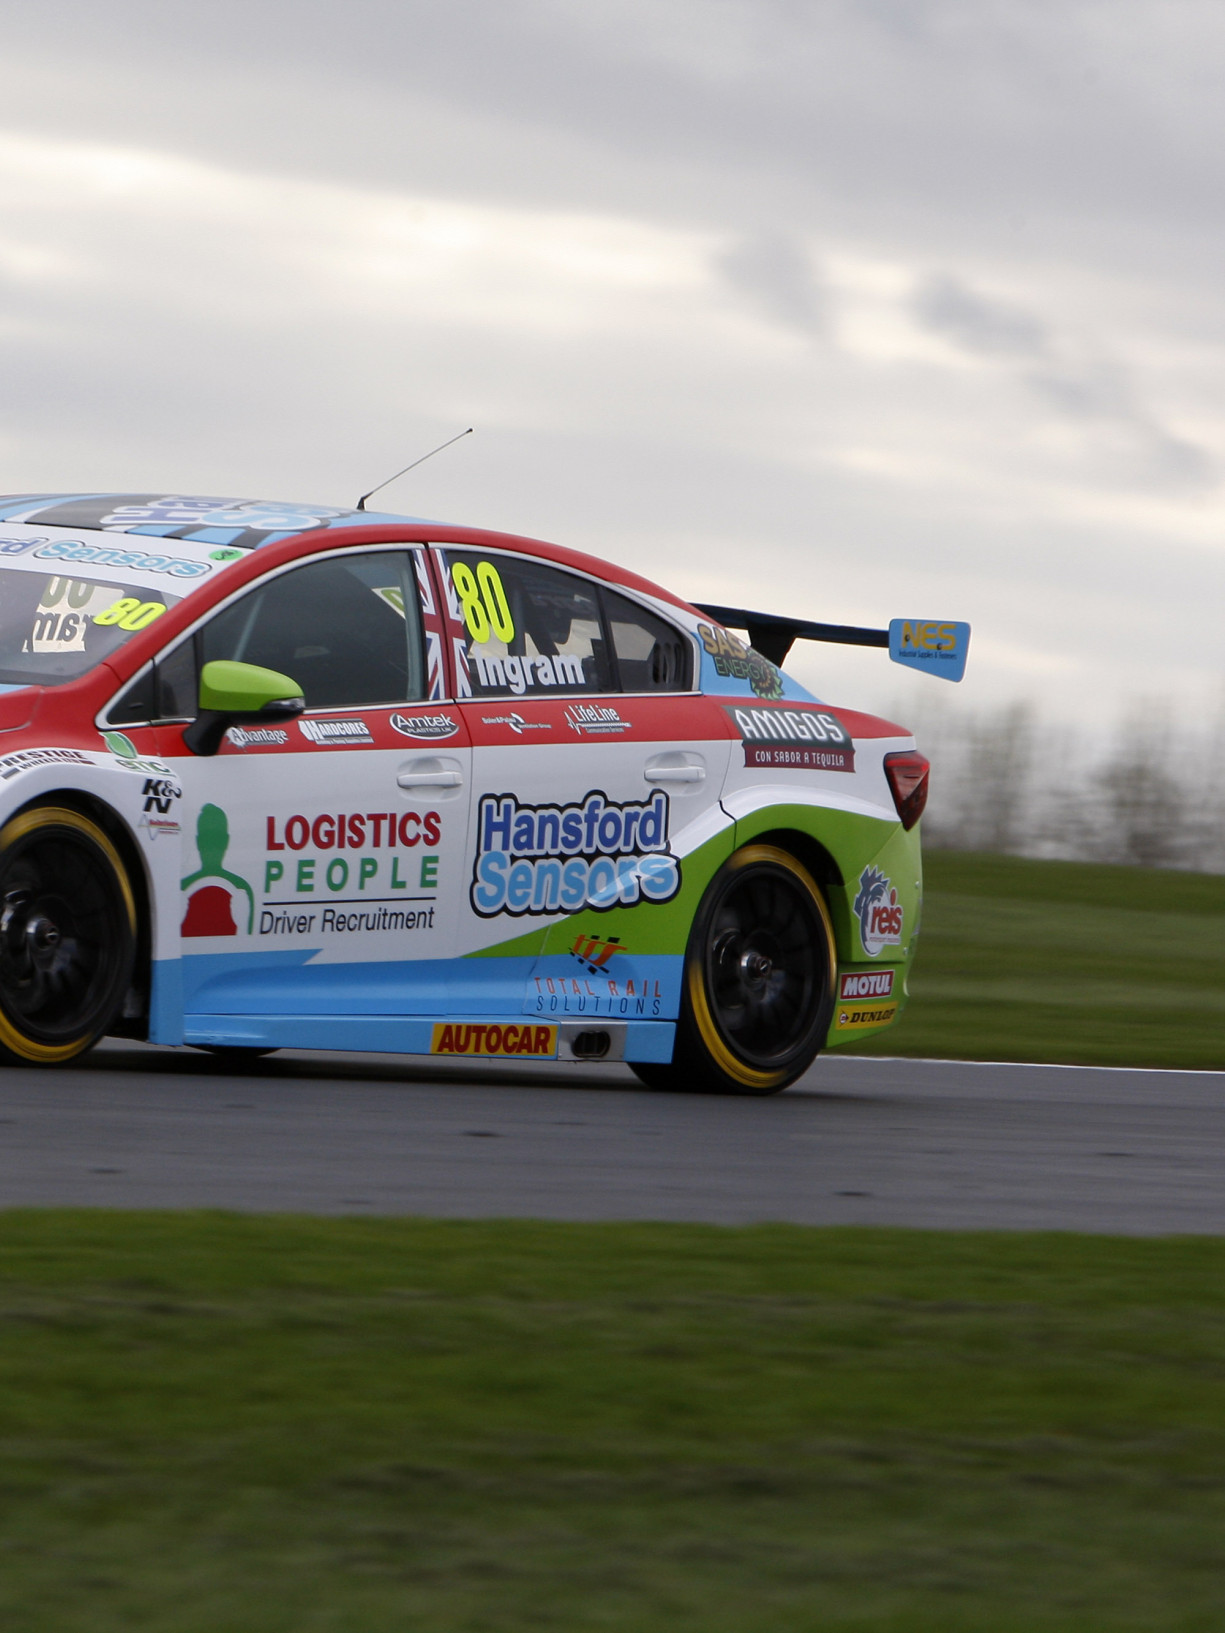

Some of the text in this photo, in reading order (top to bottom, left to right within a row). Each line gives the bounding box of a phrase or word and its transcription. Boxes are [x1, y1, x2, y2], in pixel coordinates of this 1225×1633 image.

[40, 541, 208, 576] Sensors
[92, 597, 167, 631] 80
[452, 561, 515, 643] 80
[698, 624, 748, 659] SAS
[901, 621, 956, 650] NES
[476, 648, 586, 695] Ingram
[714, 656, 765, 680] ENERGY
[397, 713, 456, 728] Amtek
[569, 704, 620, 722] LifeLine
[734, 709, 845, 743] AMIGOS
[304, 719, 370, 740] HARDCORES
[755, 750, 845, 767] CON SABOR A TEQUILA
[266, 811, 442, 851] LOGISTICS
[482, 796, 666, 852] Hansford
[264, 855, 440, 893] PEOPLE
[476, 851, 677, 908] Sensors
[259, 906, 435, 935] Driver Recruitment
[870, 888, 903, 935] reis
[534, 977, 662, 998] TOTAL RAIL
[843, 973, 892, 996] MOTUL
[536, 995, 661, 1016] SOLUTIONS
[850, 1008, 895, 1024] DUNLOP
[437, 1024, 551, 1054] AUTOCAR
